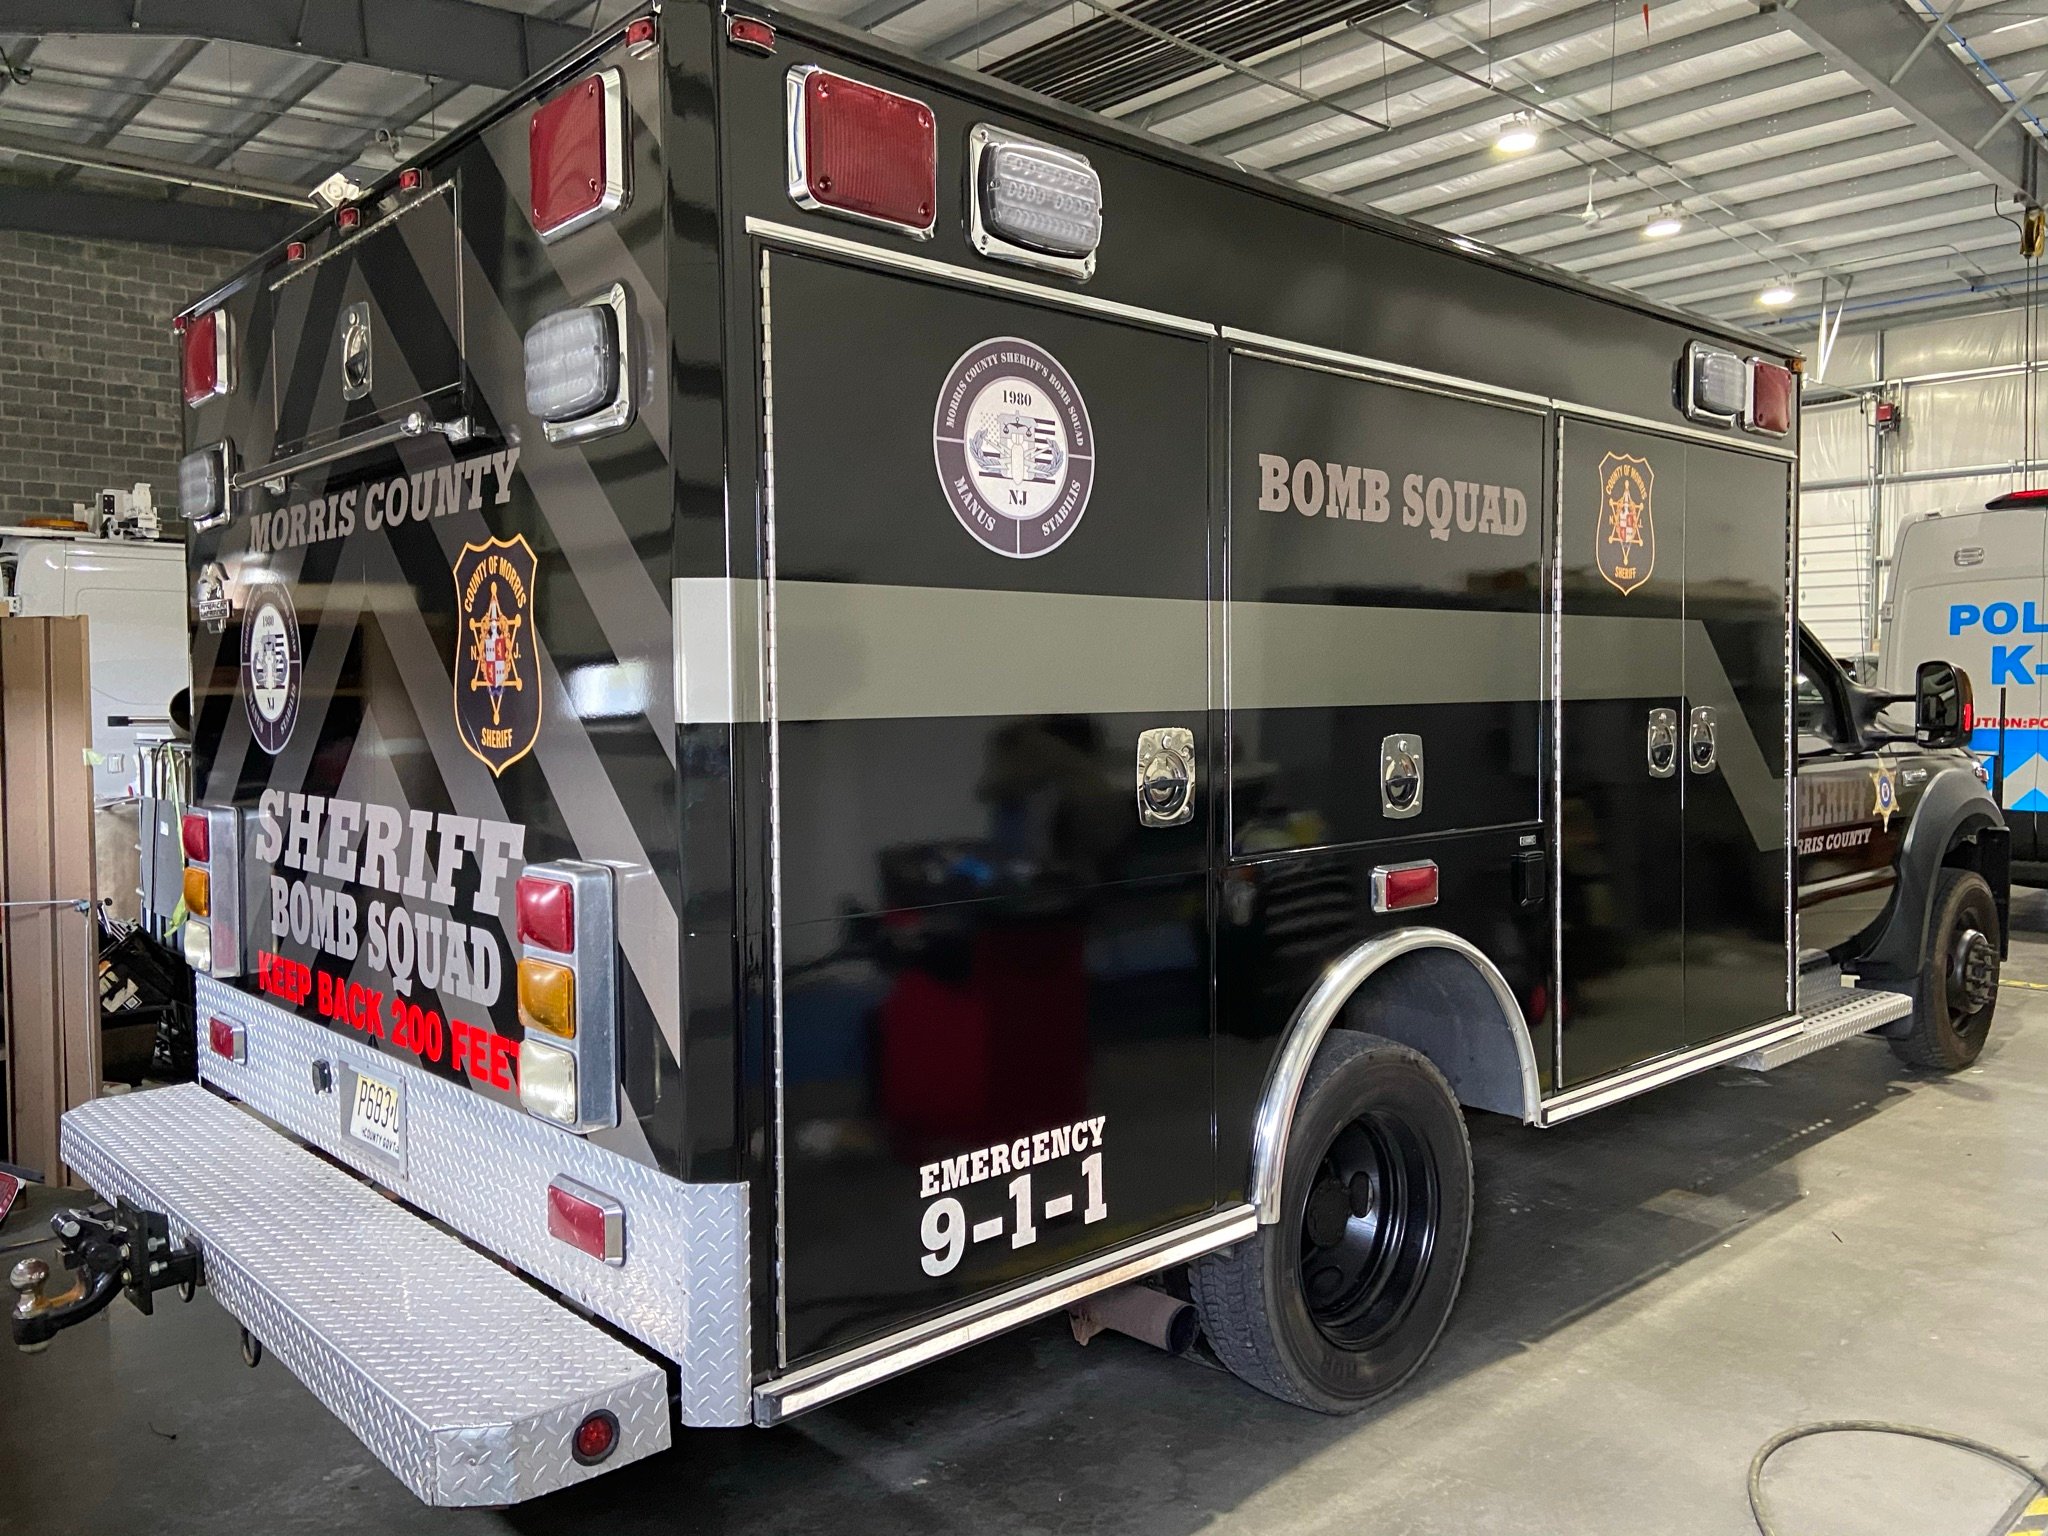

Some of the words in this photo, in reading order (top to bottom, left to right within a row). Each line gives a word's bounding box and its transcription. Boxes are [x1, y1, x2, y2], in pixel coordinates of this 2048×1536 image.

[946, 380, 967, 428] MORRIS
[964, 353, 1000, 382] COUNTY
[1000, 352, 1049, 377] SHERIFF'S
[1048, 373, 1071, 406] BOMB
[1067, 405, 1084, 447] SQUAD
[1002, 390, 1032, 407] 1980
[249, 489, 358, 553] MORRIS
[364, 447, 520, 531] COUNTY
[954, 476, 996, 532] MANUS
[1008, 489, 1027, 506] NJ
[1041, 479, 1081, 536] STABILIS
[1258, 453, 1390, 523] BOMB
[1402, 473, 1528, 541] SQUAD
[464, 559, 487, 613] COUNTY
[488, 555, 498, 575] OF
[499, 557, 527, 609] MORRIS
[1615, 566, 1636, 579] SHERIFF
[1949, 602, 2048, 635] POL
[481, 727, 513, 748] SHERIFF
[1798, 776, 1869, 828] HERIFF
[255, 788, 526, 917] SHERIFF
[1798, 836, 1825, 855] RRIS
[1826, 827, 1872, 850] COUNTY
[270, 874, 358, 962] BOMB
[368, 900, 502, 1008] SQUAD
[258, 949, 313, 1007] KEEP
[317, 970, 386, 1039] BACK
[390, 999, 443, 1063] 200
[919, 1116, 1106, 1198] EMERGENCY
[920, 1152, 1107, 1277] 9-1-1
